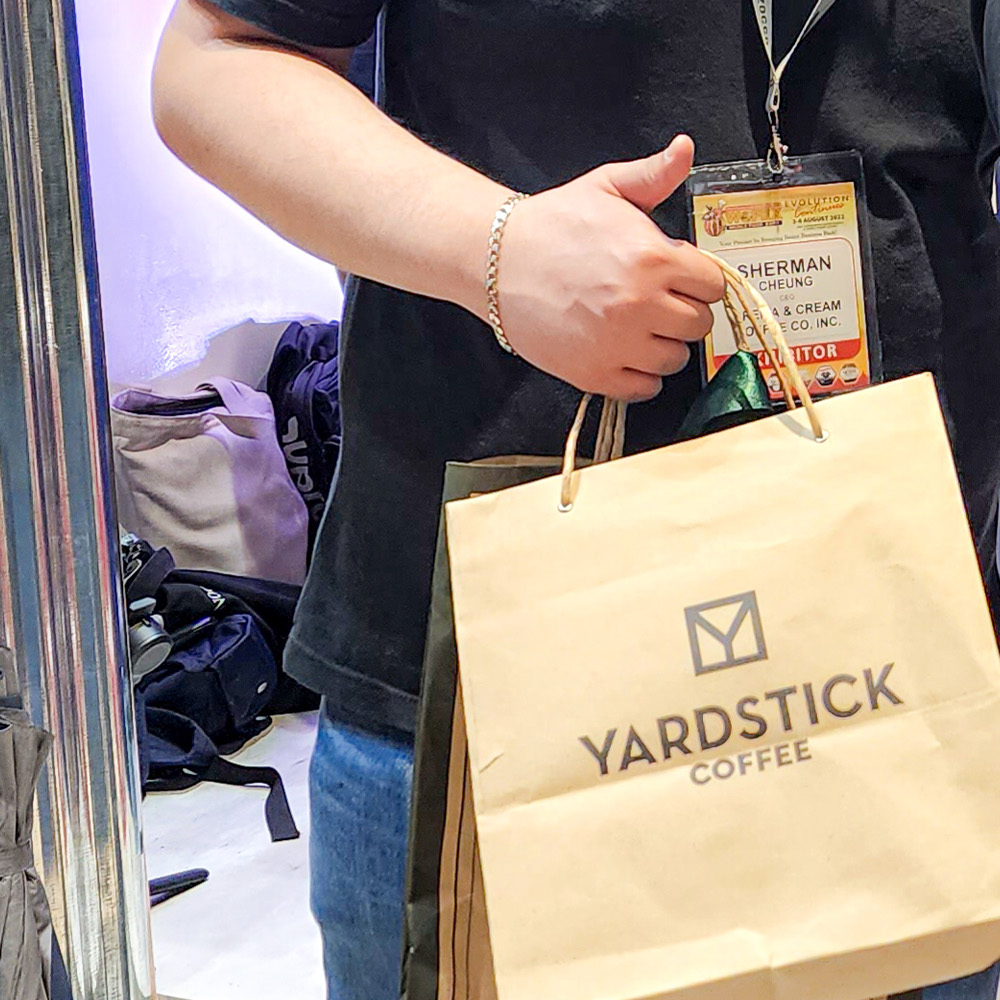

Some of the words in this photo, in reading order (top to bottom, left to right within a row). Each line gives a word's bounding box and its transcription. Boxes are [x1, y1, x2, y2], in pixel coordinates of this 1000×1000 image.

[737, 255, 832, 278] SHERMAN
[758, 275, 814, 291] CHEUNG
[796, 300, 842, 315] CREAM
[791, 321, 813, 332] CO.
[816, 316, 841, 329] INC.
[578, 662, 904, 776] YARDSTICK
[689, 738, 812, 785] COFFEE
